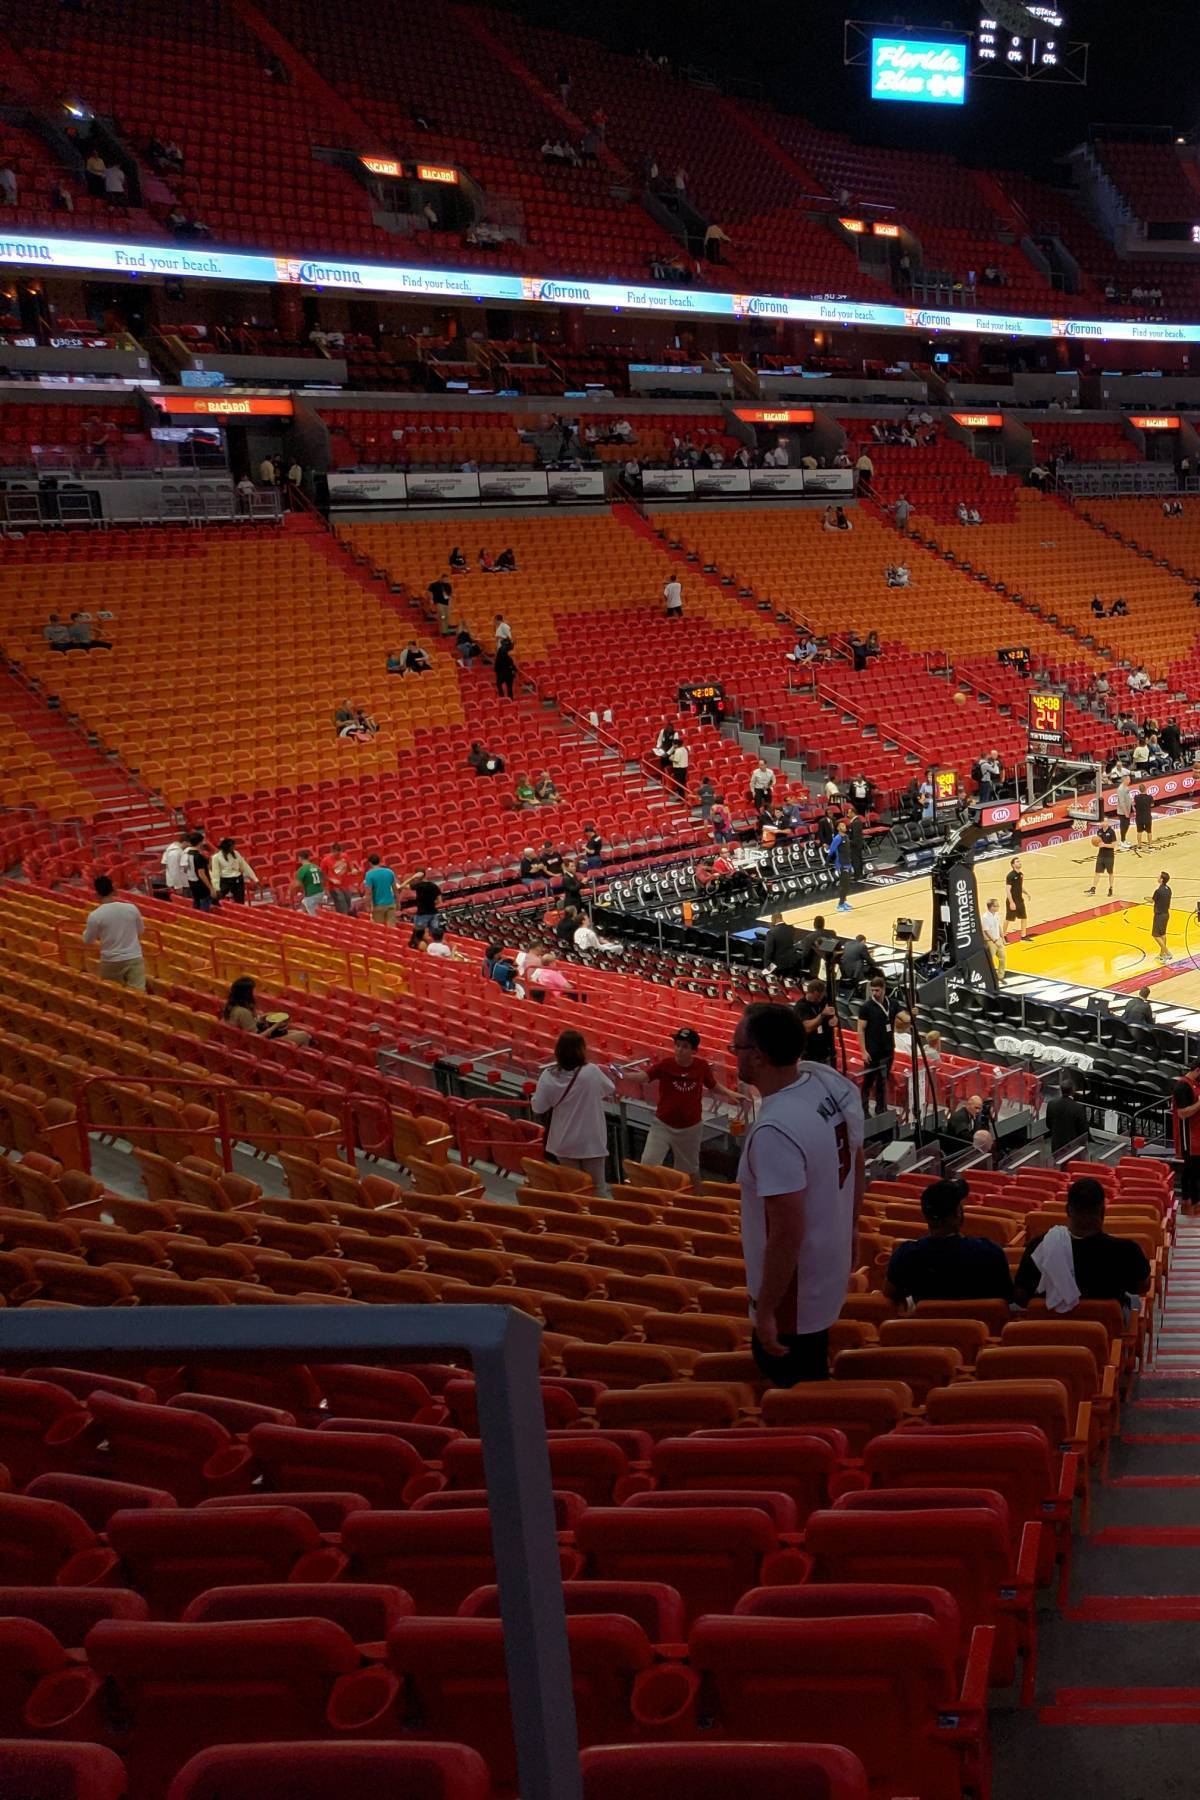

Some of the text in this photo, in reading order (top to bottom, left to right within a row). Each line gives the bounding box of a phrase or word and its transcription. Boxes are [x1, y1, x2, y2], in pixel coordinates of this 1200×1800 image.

[877, 45, 962, 72] Florida
[875, 70, 923, 92] Blue
[0, 243, 51, 260] rona
[115, 251, 146, 267] Find
[149, 258, 179, 271] your
[299, 262, 361, 284] Corona
[402, 275, 423, 288] Find
[423, 280, 444, 291] your
[541, 281, 590, 301] Corona
[627, 291, 647, 304] Find
[648, 296, 668, 307] your
[748, 298, 788, 314] Corona
[820, 306, 836, 318] Find
[916, 312, 950, 327] Corona
[976, 318, 991, 329] Find
[1064, 321, 1102, 336] Corona
[1132, 327, 1147, 338] Find
[692, 688, 714, 698] 42:08
[1033, 696, 1060, 710] 42:08
[1036, 709, 1057, 730] 24
[1039, 733, 1061, 742] TISSOT
[939, 784, 953, 797] 24
[866, 862, 873, 870] G
[819, 873, 827, 881] G
[673, 906, 681, 915] G
[956, 880, 972, 949] Ultimate
